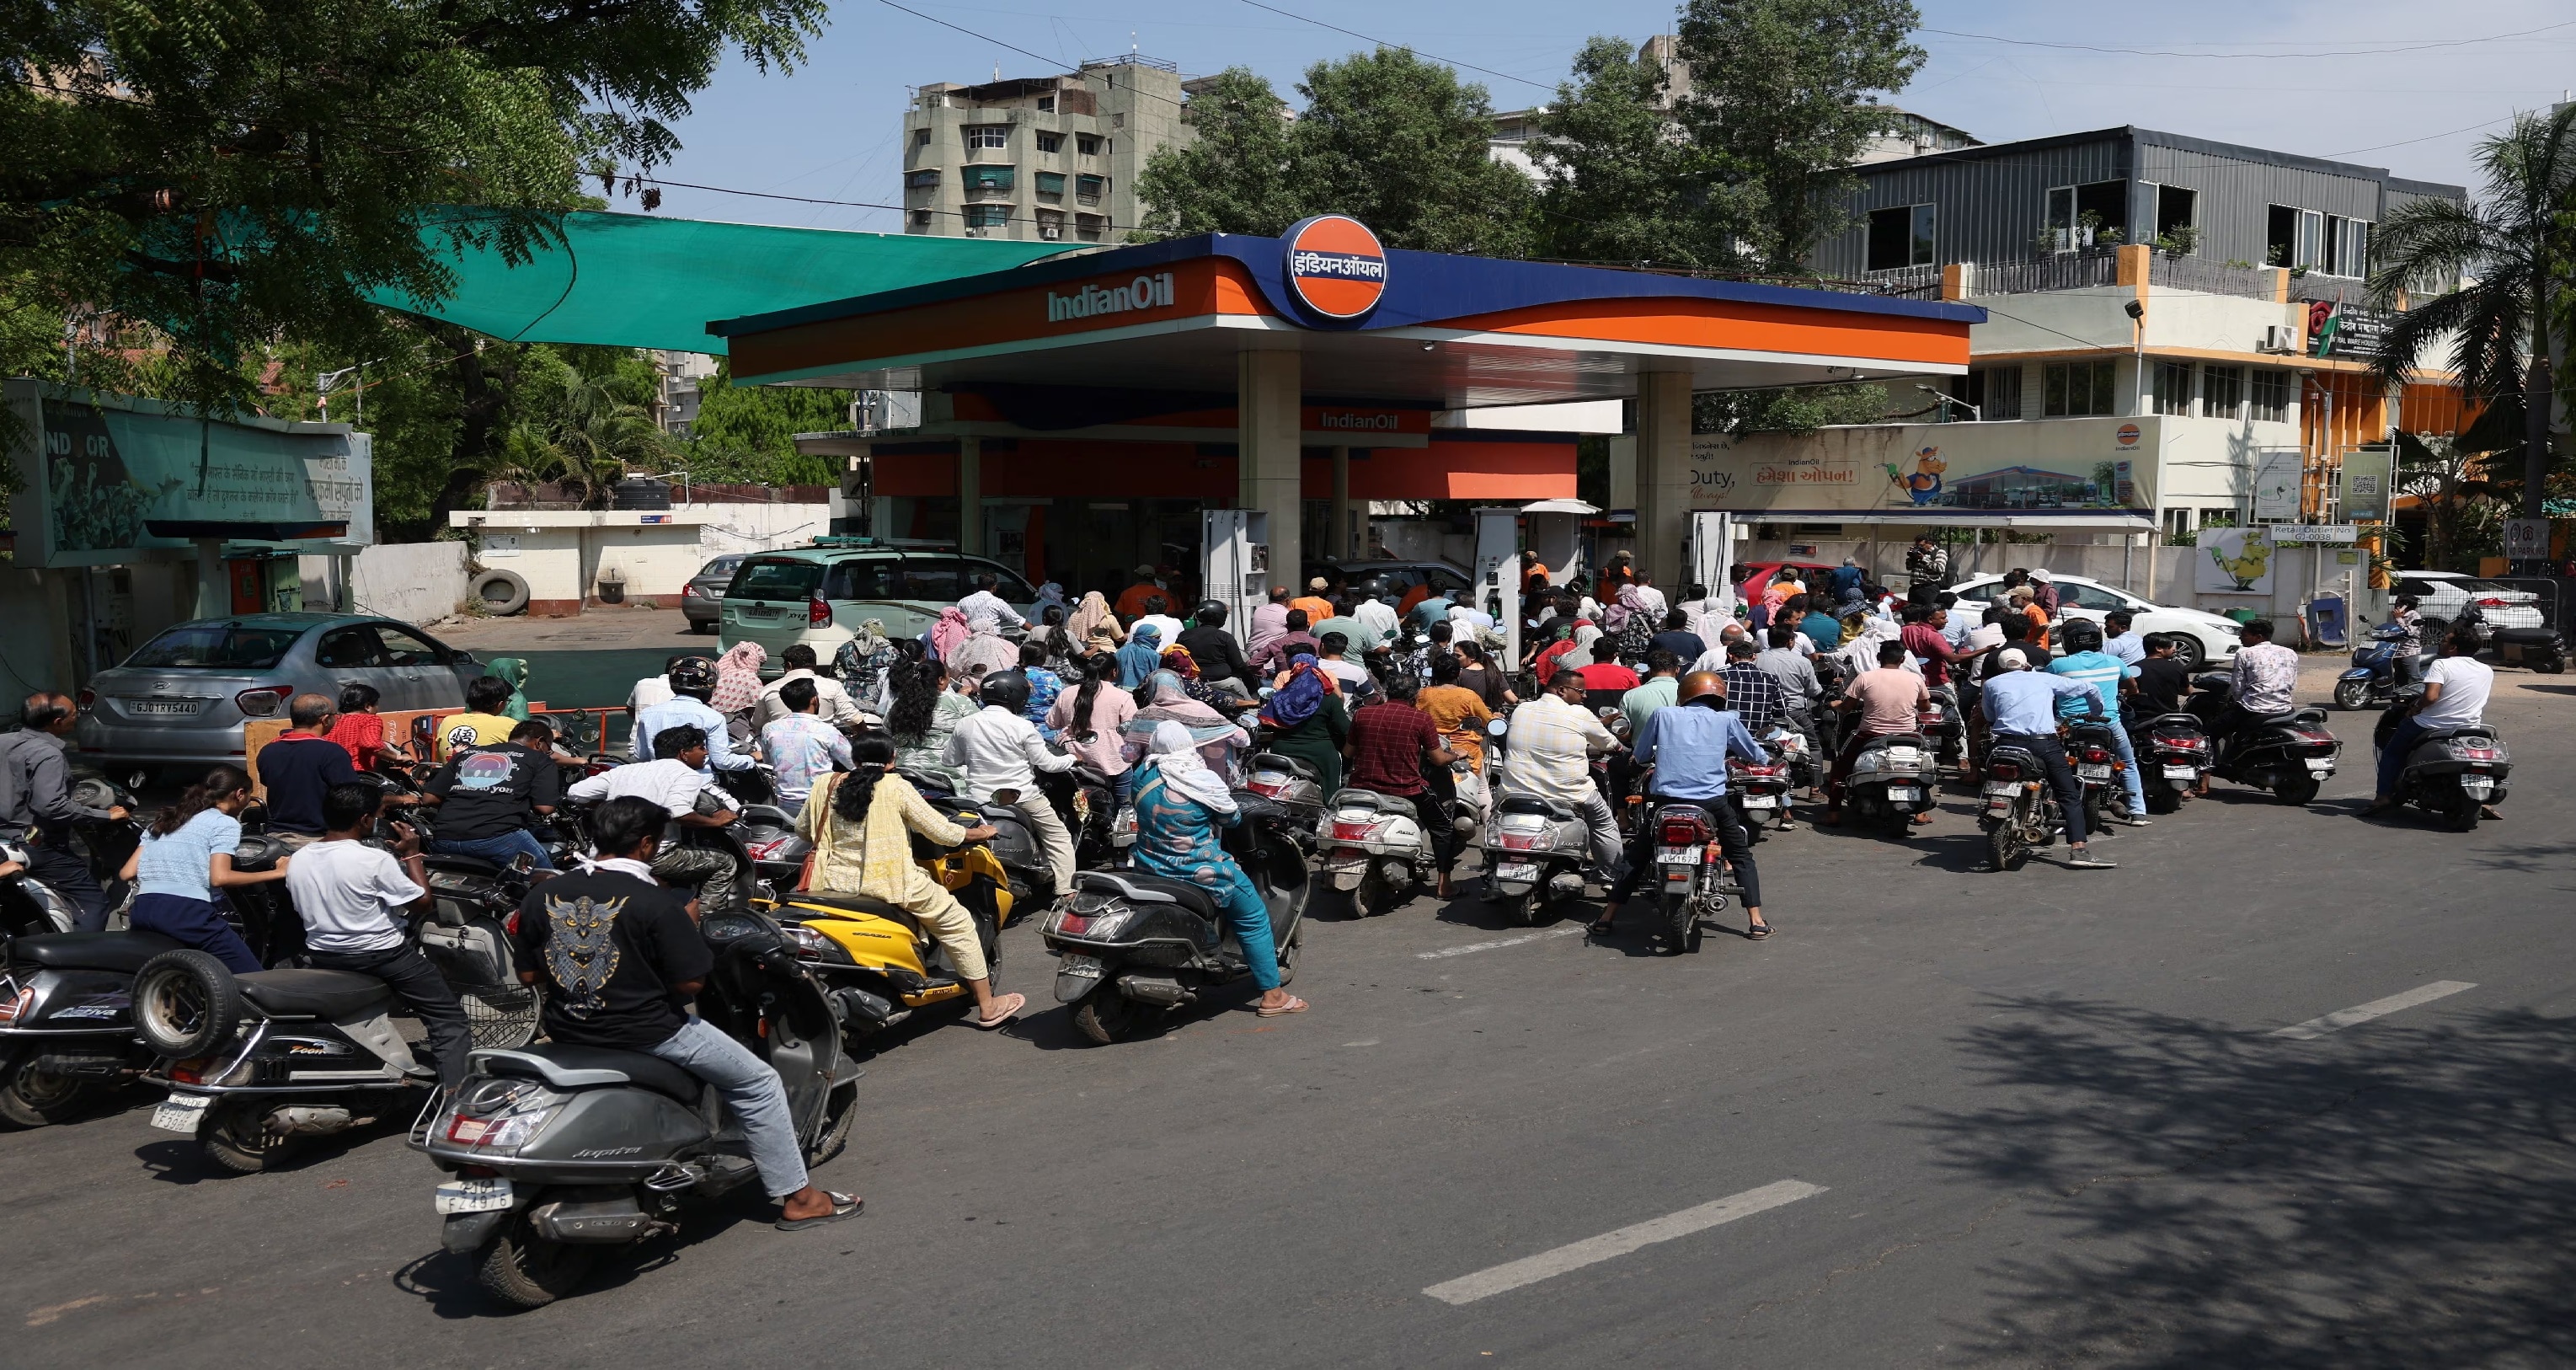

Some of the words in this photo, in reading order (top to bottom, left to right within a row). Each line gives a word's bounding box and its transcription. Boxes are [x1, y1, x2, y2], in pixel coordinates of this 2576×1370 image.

[1294, 252, 1383, 277] इंडियनऑयल
[1048, 272, 1174, 322] IndianOil
[1322, 412, 1398, 429] IndianOil
[1800, 466, 1853, 483] ઓપન!
[354, 477, 364, 503] को
[2275, 526, 2301, 534] Retail
[2304, 526, 2333, 534] Outlet
[2337, 526, 2350, 534] No
[2518, 547, 2546, 556] PARKING
[1671, 847, 1692, 855] GJ01
[1510, 864, 1530, 872] GJ01
[49, 1007, 118, 1019] Activa
[290, 1045, 326, 1055] Zoom
[573, 1147, 642, 1159] Jupiter
